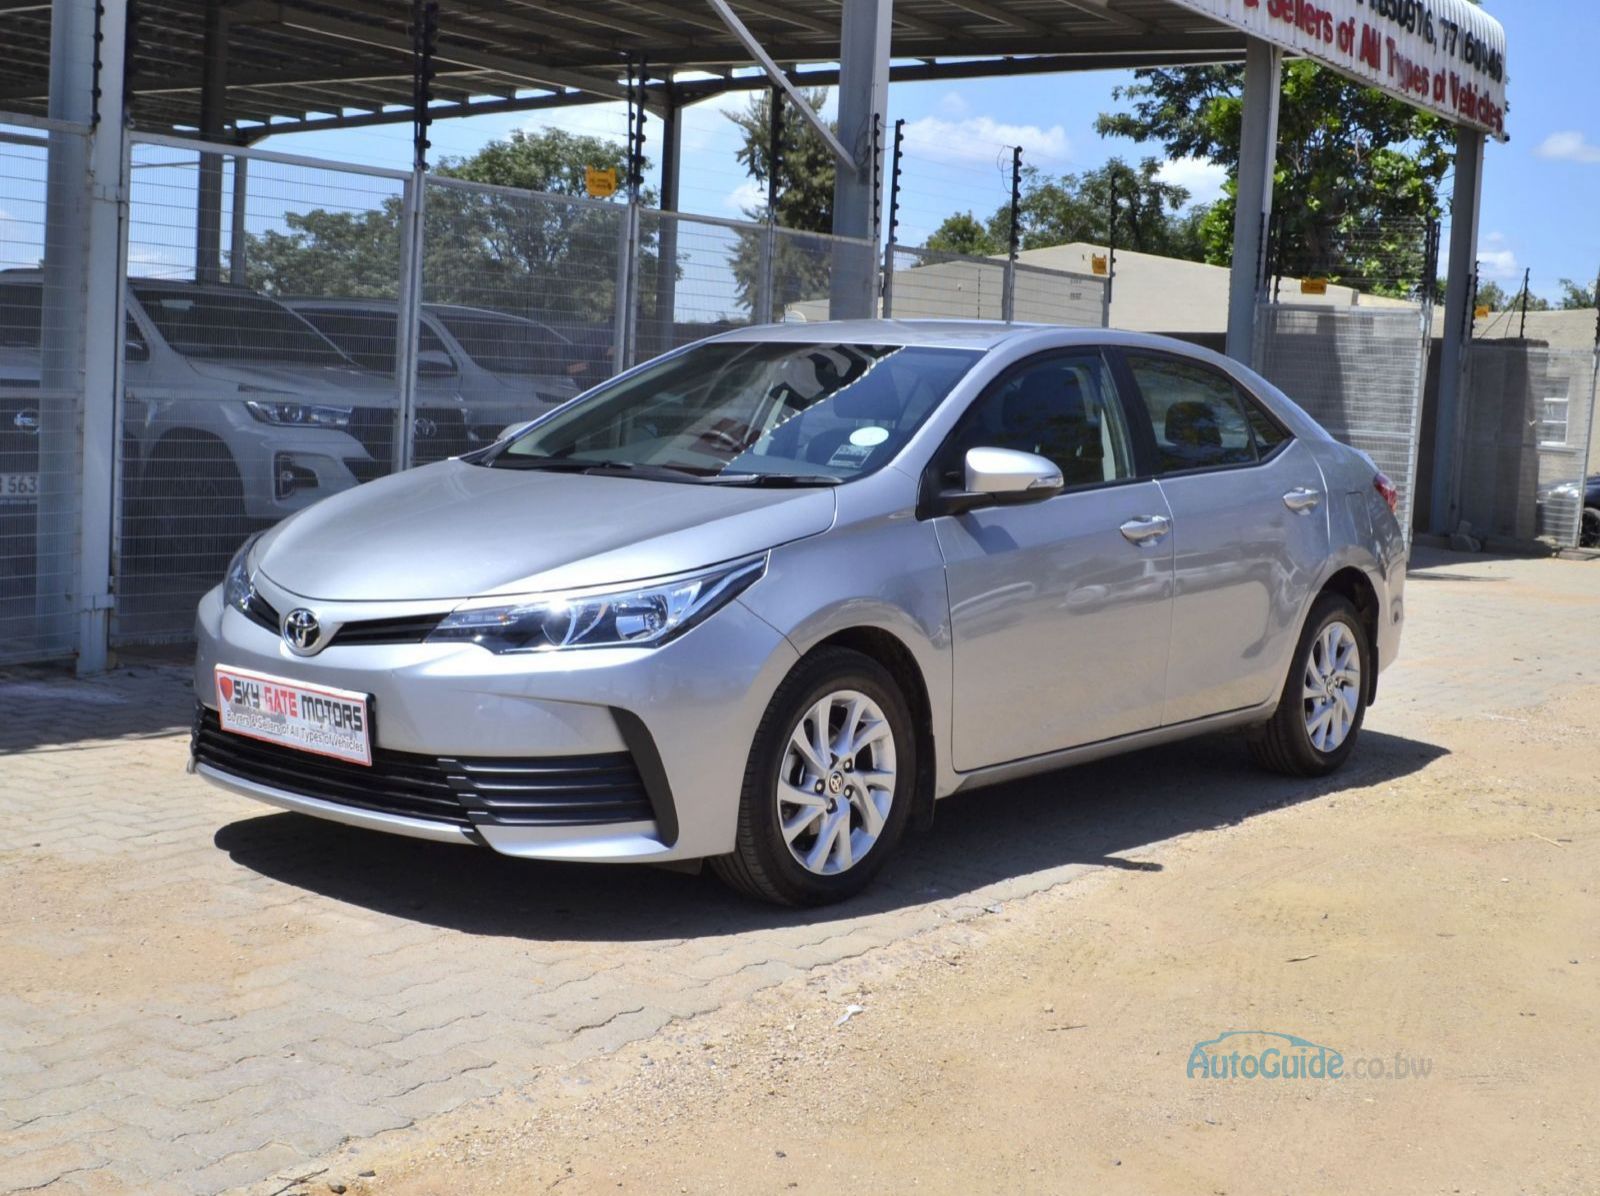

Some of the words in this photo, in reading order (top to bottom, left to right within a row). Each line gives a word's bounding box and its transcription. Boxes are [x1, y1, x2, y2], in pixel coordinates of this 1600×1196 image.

[1338, 17, 1355, 57] of
[1359, 23, 1381, 71] All
[1386, 36, 1430, 96] Types
[1433, 67, 1446, 103] of
[1449, 71, 1503, 133] Vehicles
[233, 680, 260, 709] SKY
[264, 686, 298, 718] GATE
[301, 695, 363, 732] MOTORS
